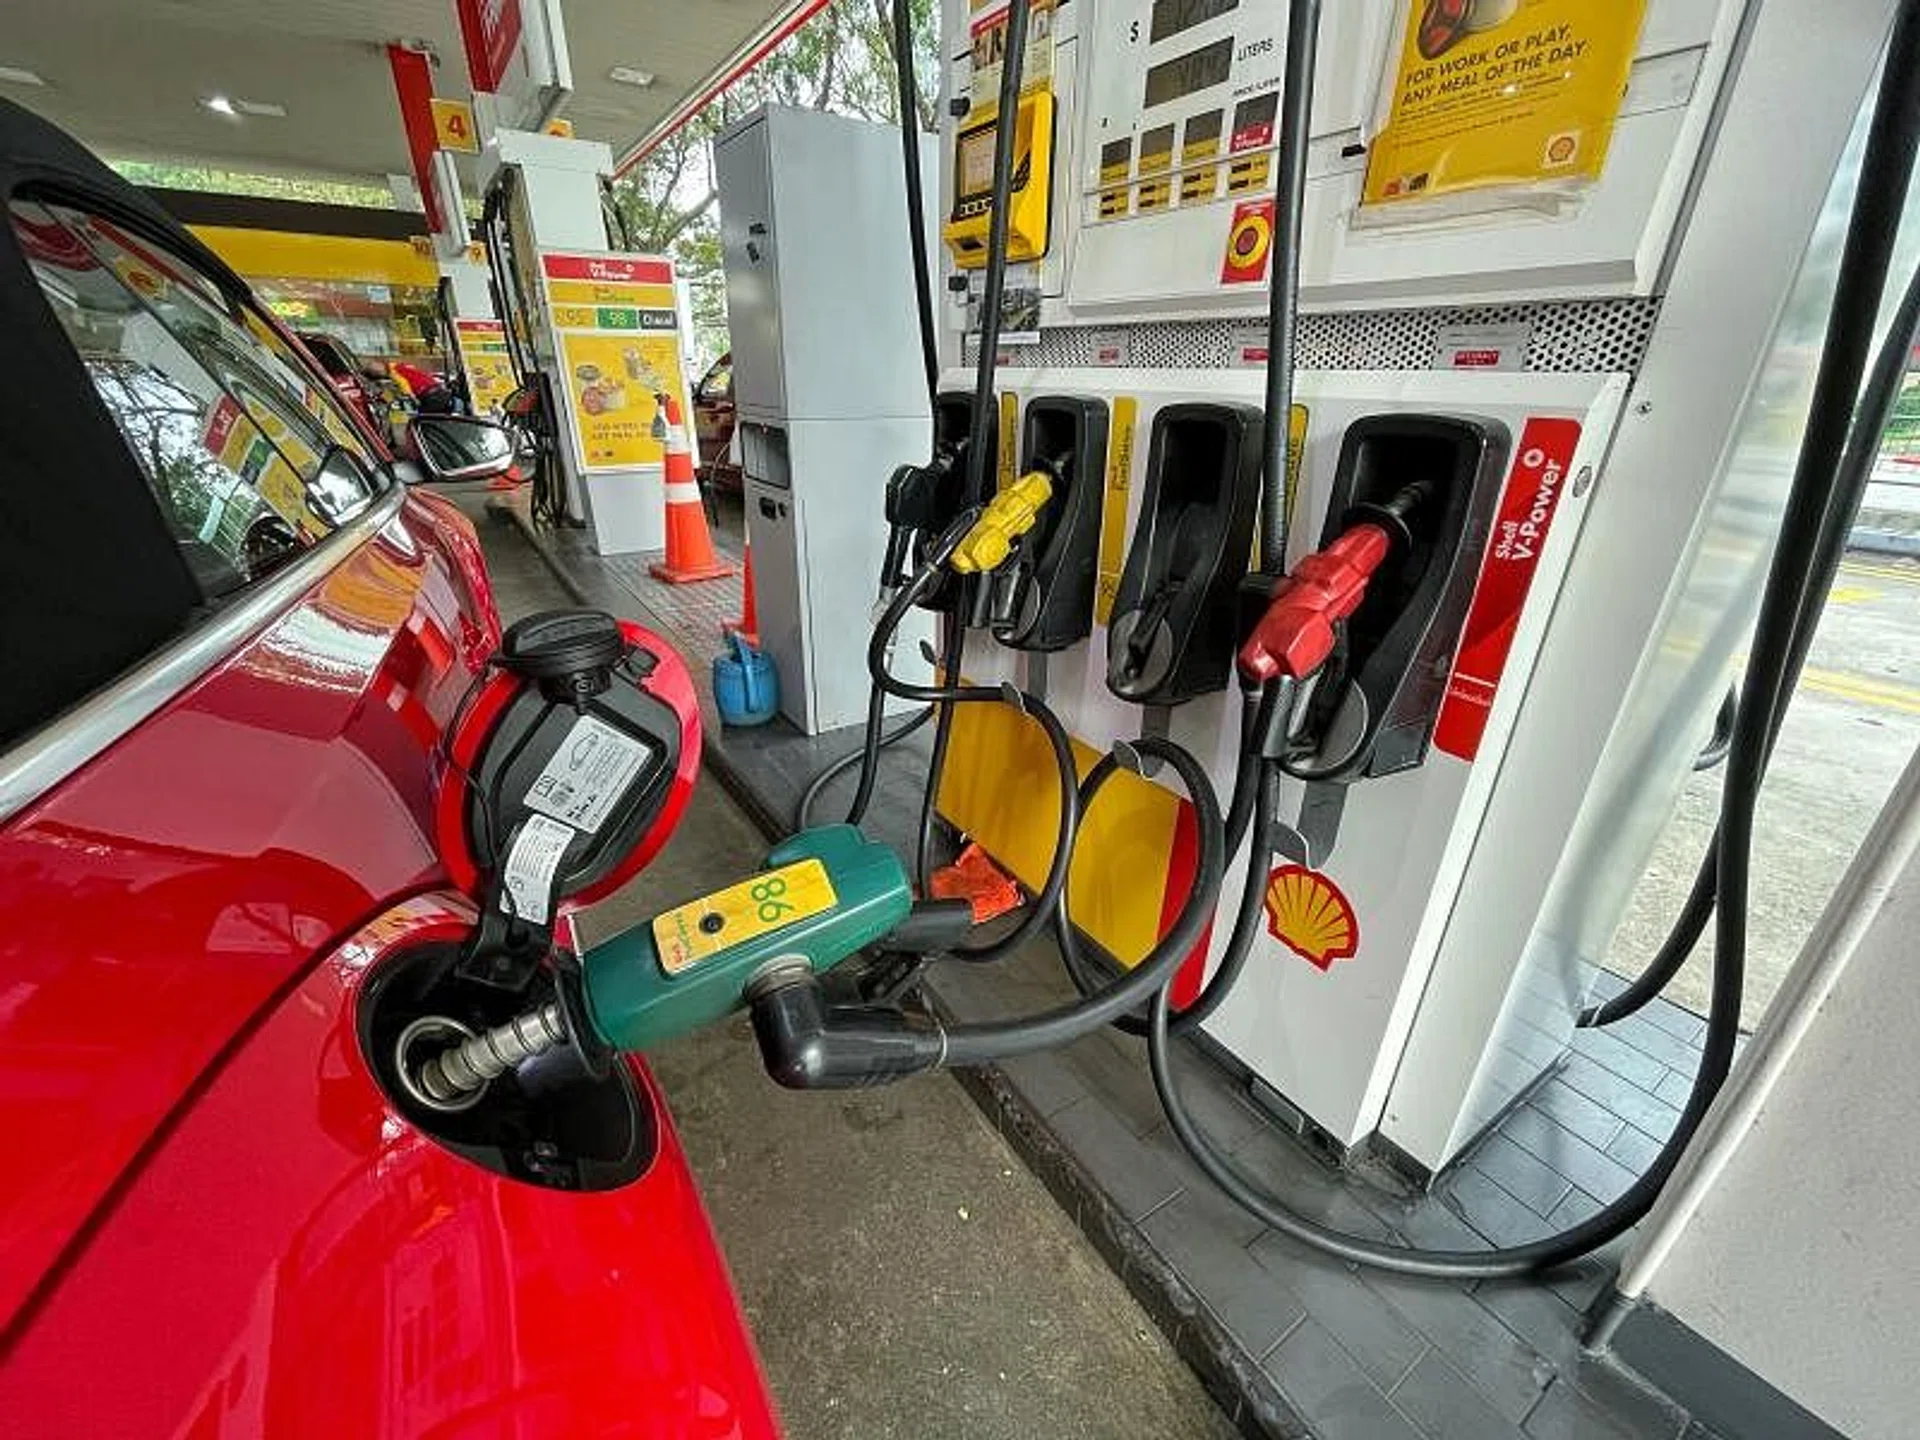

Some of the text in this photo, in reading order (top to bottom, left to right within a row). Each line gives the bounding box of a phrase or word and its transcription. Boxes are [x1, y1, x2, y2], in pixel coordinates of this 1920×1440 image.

[1130, 21, 1140, 43] $
[1238, 38, 1273, 61] LITERS
[1401, 83, 1433, 107] ANY
[1438, 71, 1479, 95] MEAL
[1485, 62, 1510, 81] OF
[1512, 53, 1544, 74] THE
[1405, 66, 1434, 86] FOR
[1439, 52, 1488, 76] WORK
[1495, 40, 1521, 60] OR
[448, 115, 466, 139] 4
[1511, 458, 1562, 561] V-Power
[1496, 520, 1518, 559] Shell
